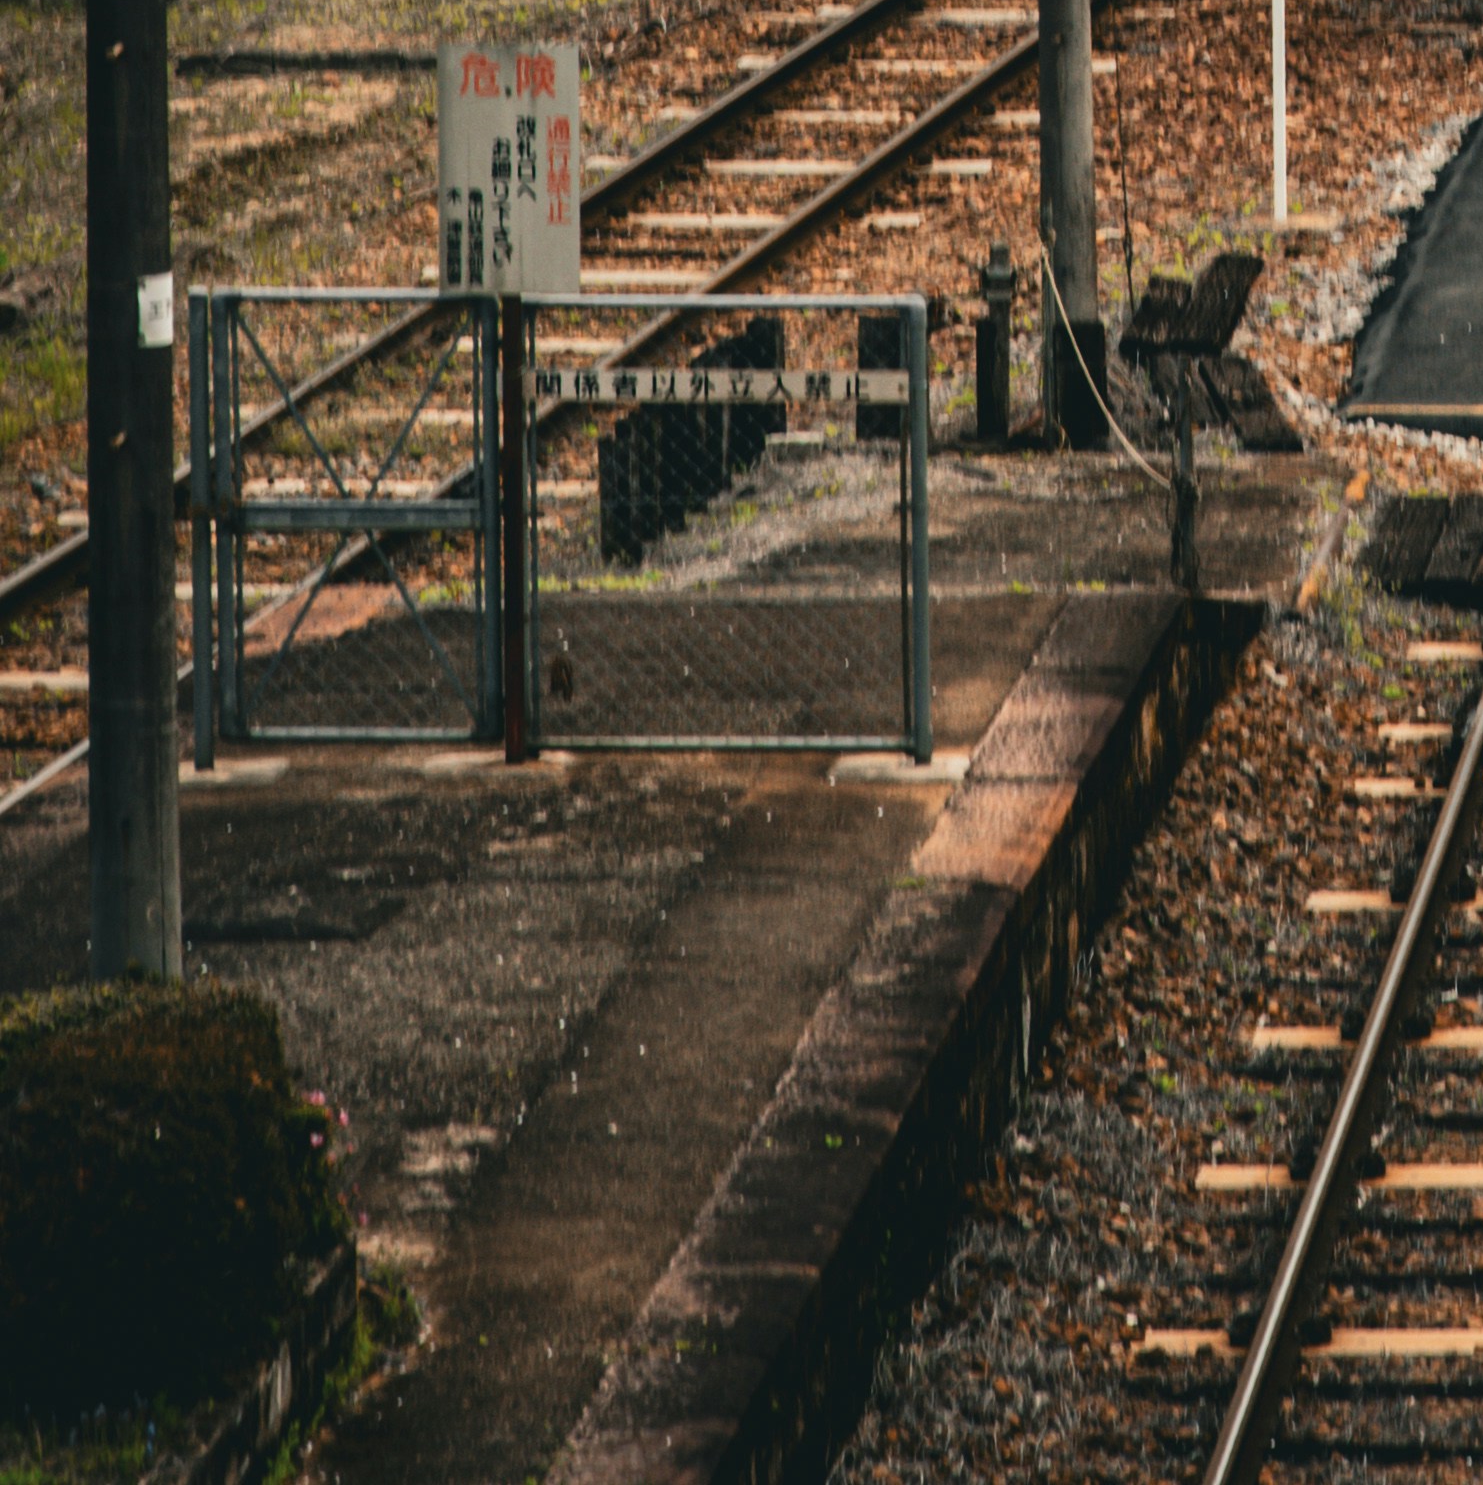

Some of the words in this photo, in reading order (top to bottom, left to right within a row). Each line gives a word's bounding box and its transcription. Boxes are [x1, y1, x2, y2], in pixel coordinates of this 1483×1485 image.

[459, 51, 556, 99] 危険
[546, 114, 572, 226] 通行禁止
[535, 370, 871, 401] 関係者以外立入禁止
